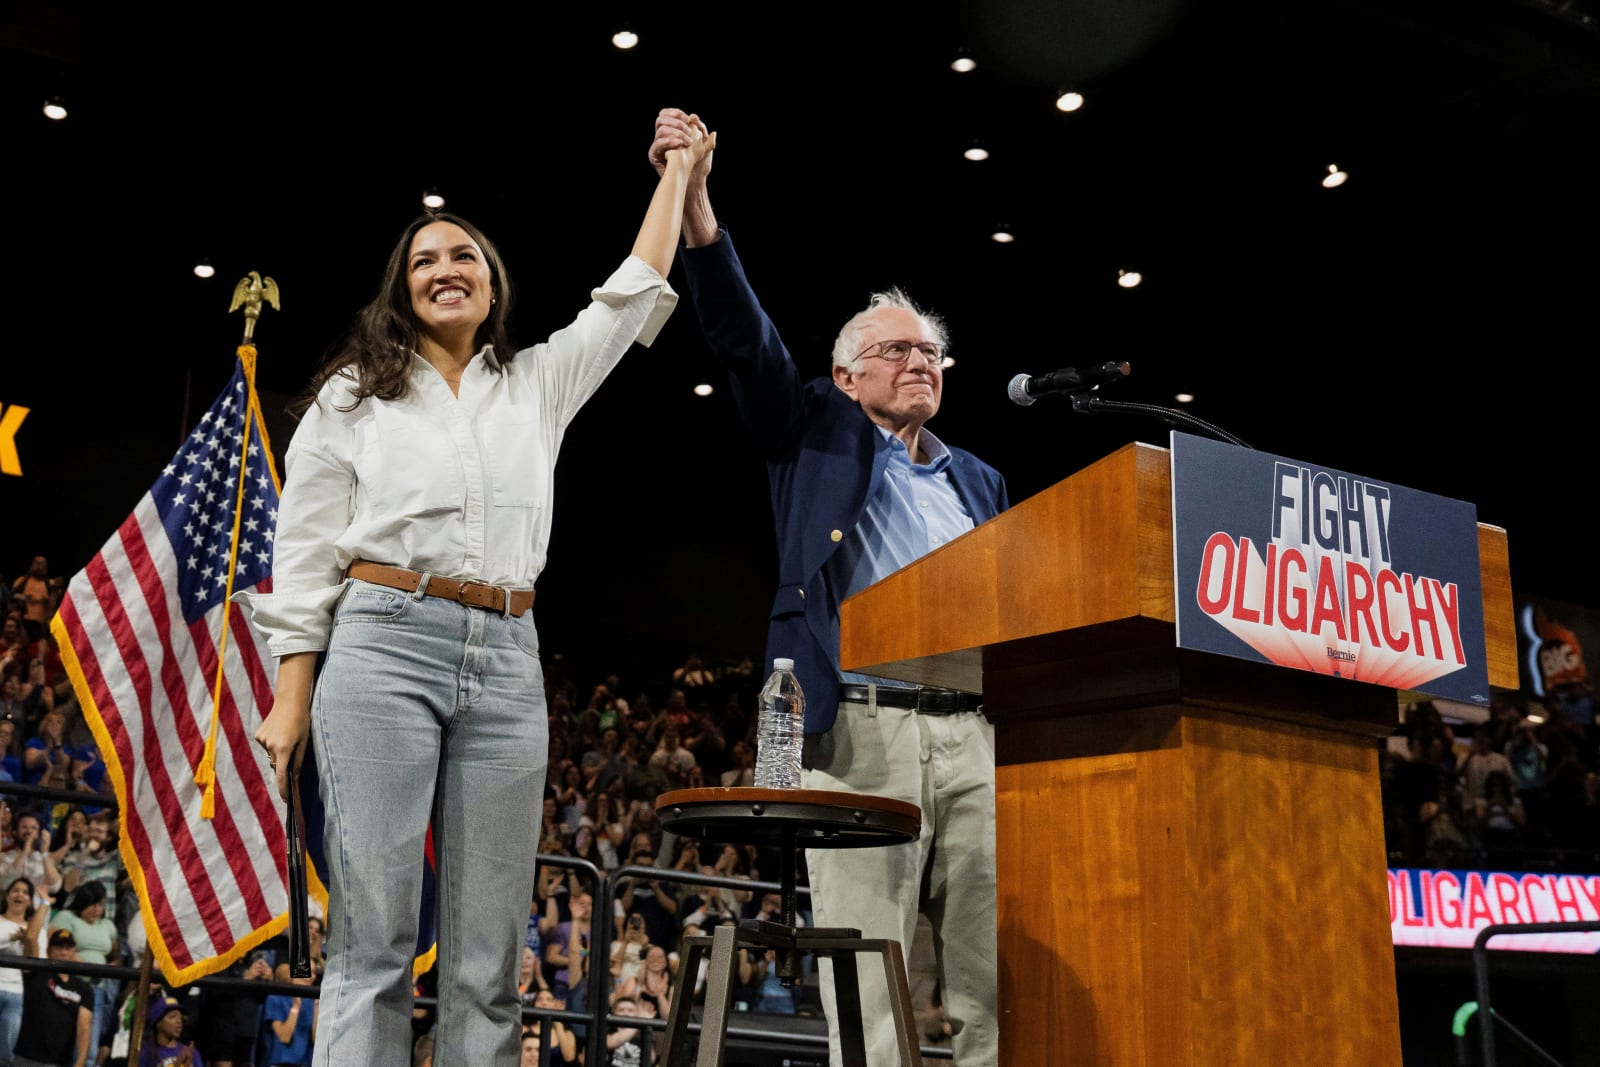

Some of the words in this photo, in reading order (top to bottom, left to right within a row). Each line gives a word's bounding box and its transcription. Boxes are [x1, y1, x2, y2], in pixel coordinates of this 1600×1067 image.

[1271, 461, 1391, 563] FIGHT
[1197, 531, 1466, 665] OLIGARCHY
[1327, 646, 1356, 662] Bernie
